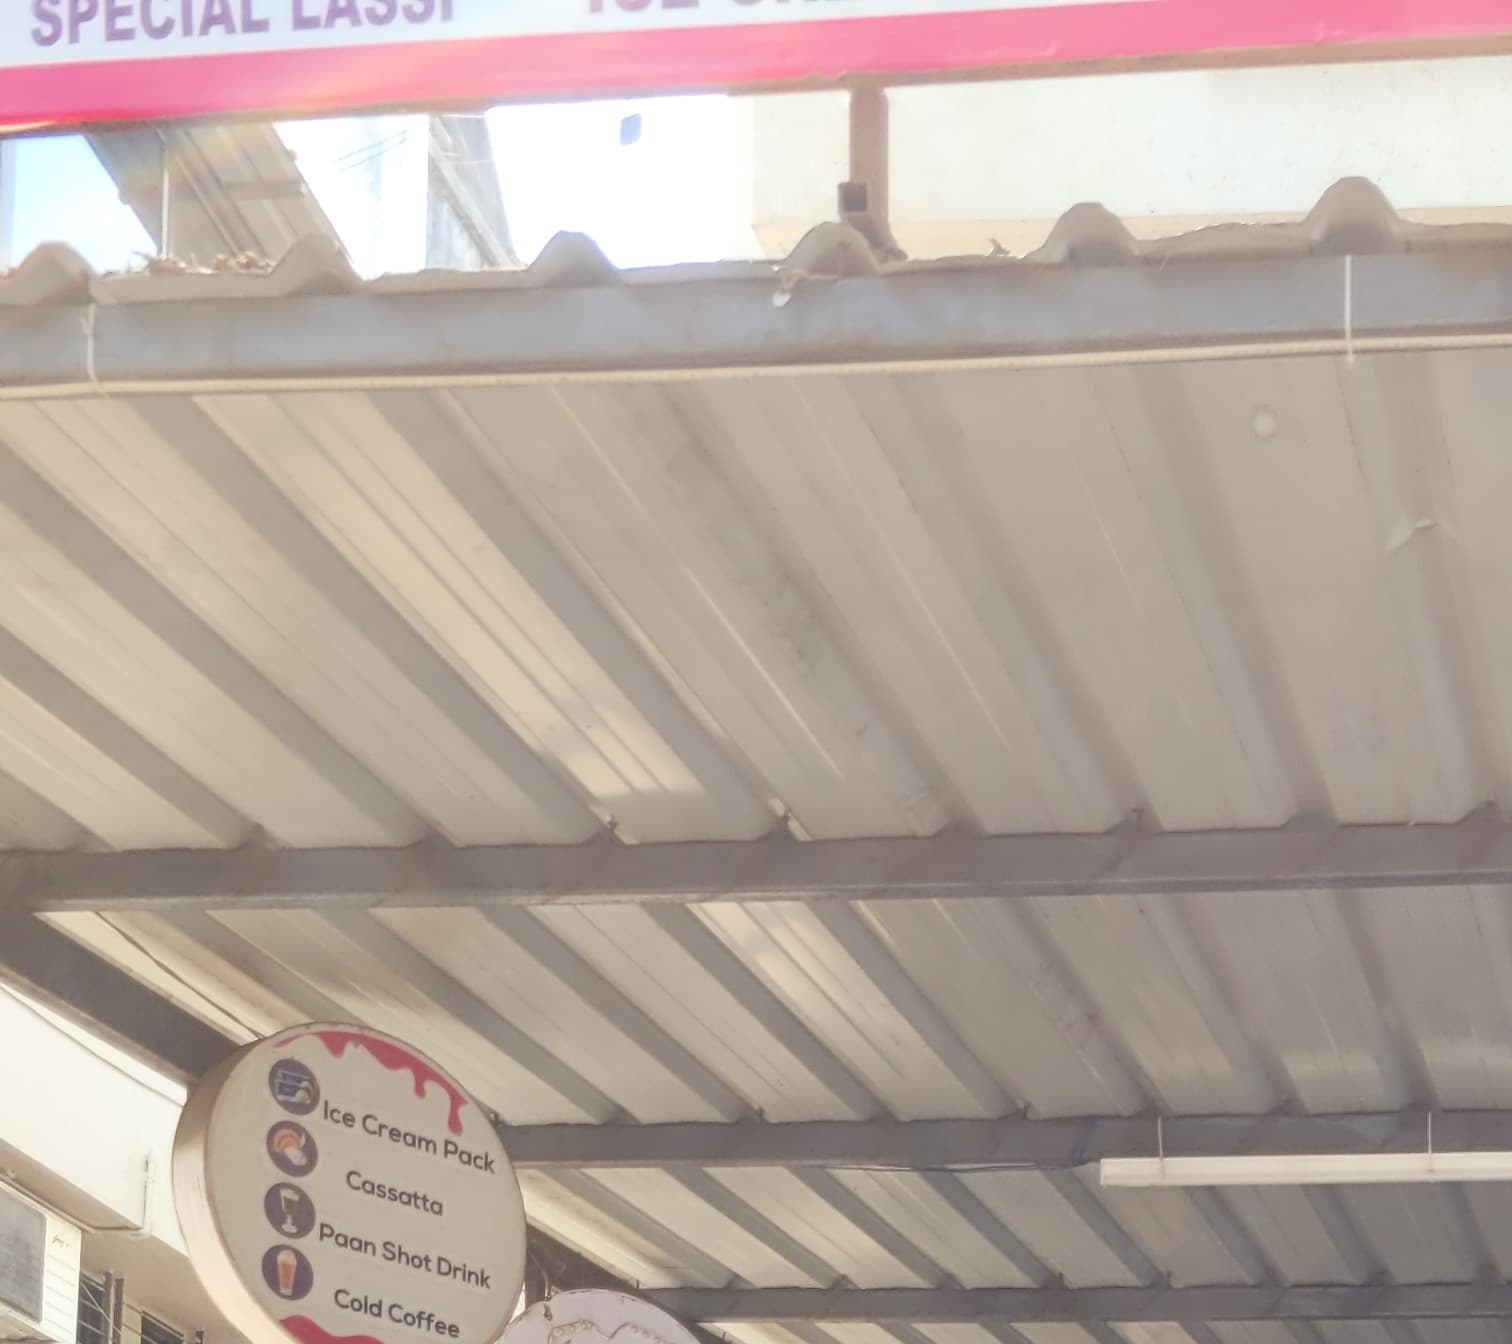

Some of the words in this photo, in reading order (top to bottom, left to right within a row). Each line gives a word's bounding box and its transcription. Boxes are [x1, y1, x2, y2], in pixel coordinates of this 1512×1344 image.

[31, 0, 270, 47] SPECIAL
[323, 1100, 356, 1128] Ice
[361, 1113, 437, 1155] Cream
[444, 1139, 496, 1174] Pack
[345, 1170, 443, 1217] Cassatta
[319, 1222, 376, 1256] Paan
[381, 1241, 432, 1272] Shot
[437, 1256, 491, 1289] Drink
[334, 1288, 383, 1319] Cold
[388, 1303, 460, 1338] Coffee
